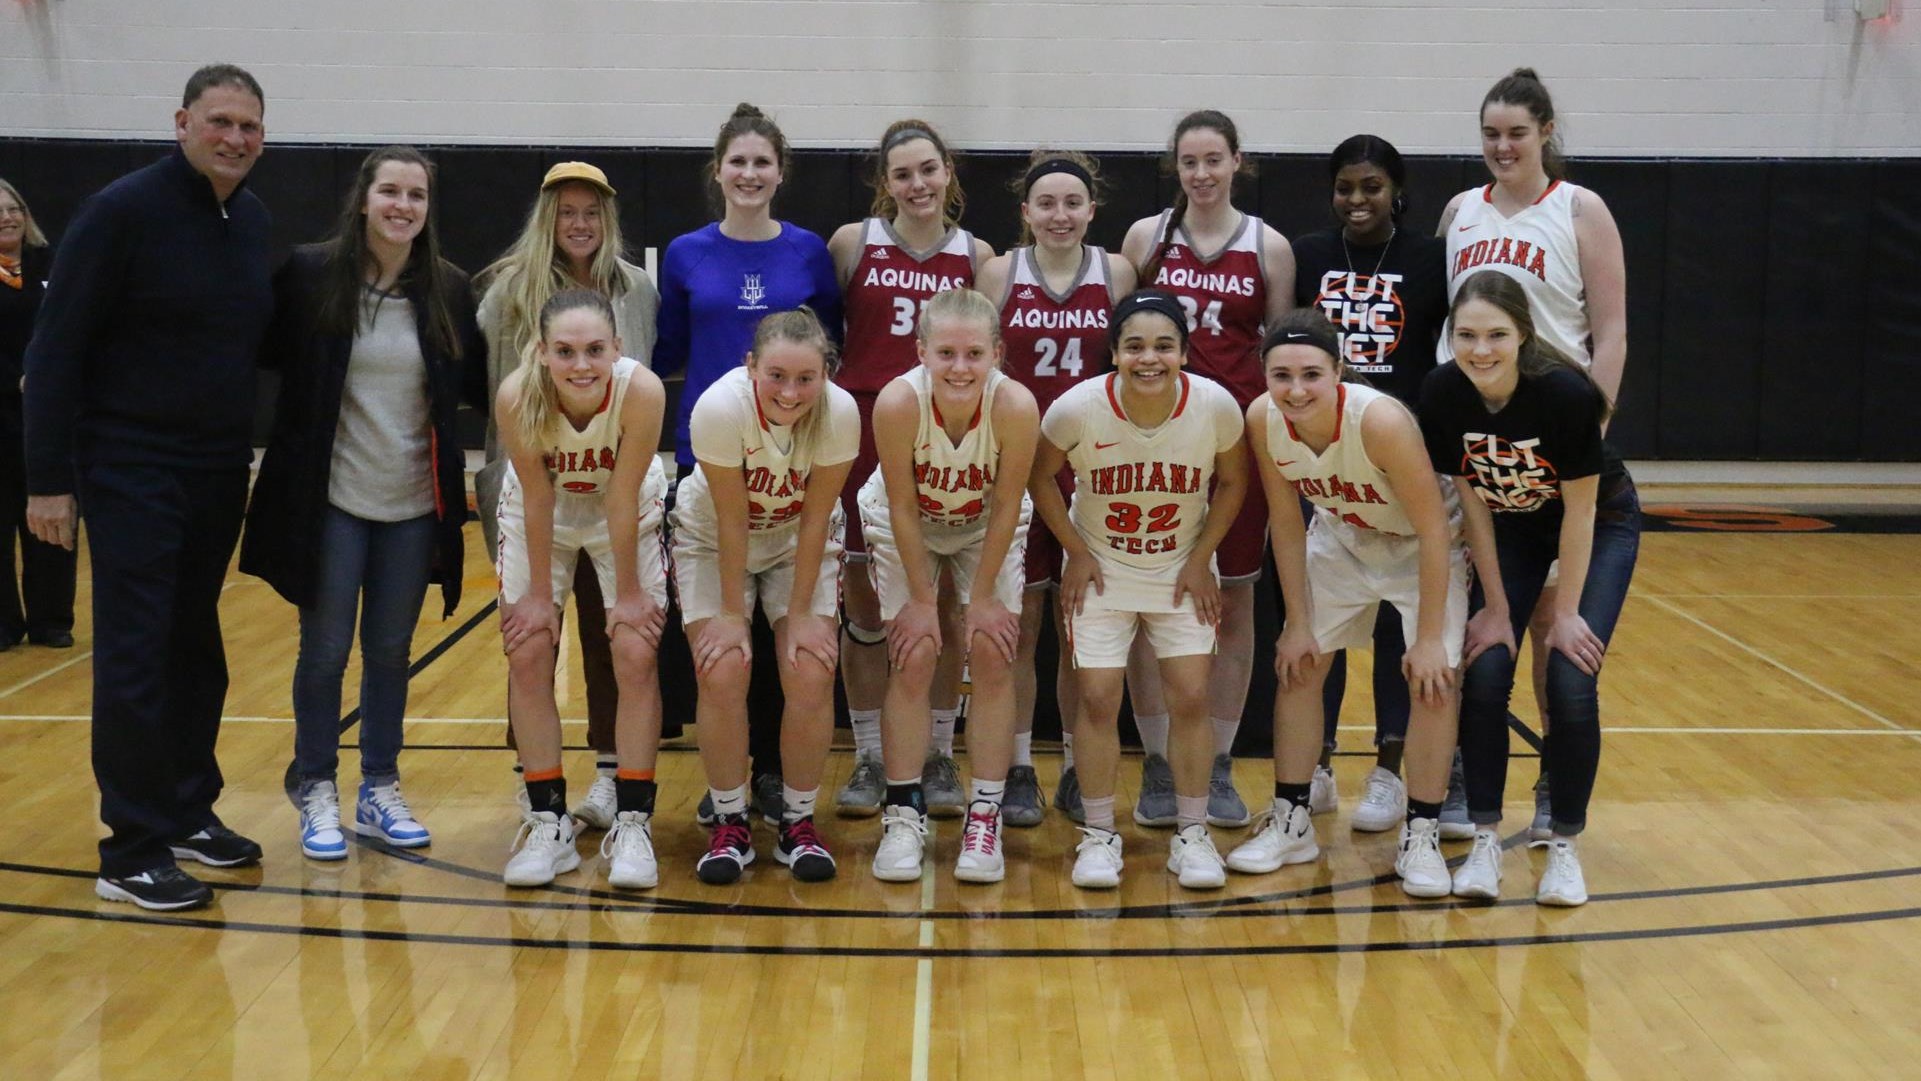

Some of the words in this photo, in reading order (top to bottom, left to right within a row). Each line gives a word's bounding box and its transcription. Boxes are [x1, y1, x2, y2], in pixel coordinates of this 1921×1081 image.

[1154, 266, 1255, 297] AQUINAS
[1319, 270, 1403, 302] CUT
[1008, 307, 1109, 329] AQUINAS
[1176, 295, 1224, 336] 34
[1320, 300, 1395, 334] THE
[1033, 337, 1084, 378] 24
[1462, 432, 1541, 470] CUT
[1090, 461, 1202, 495] INDIANA
[1105, 502, 1182, 534] 32
[1106, 533, 1177, 555] TECH
